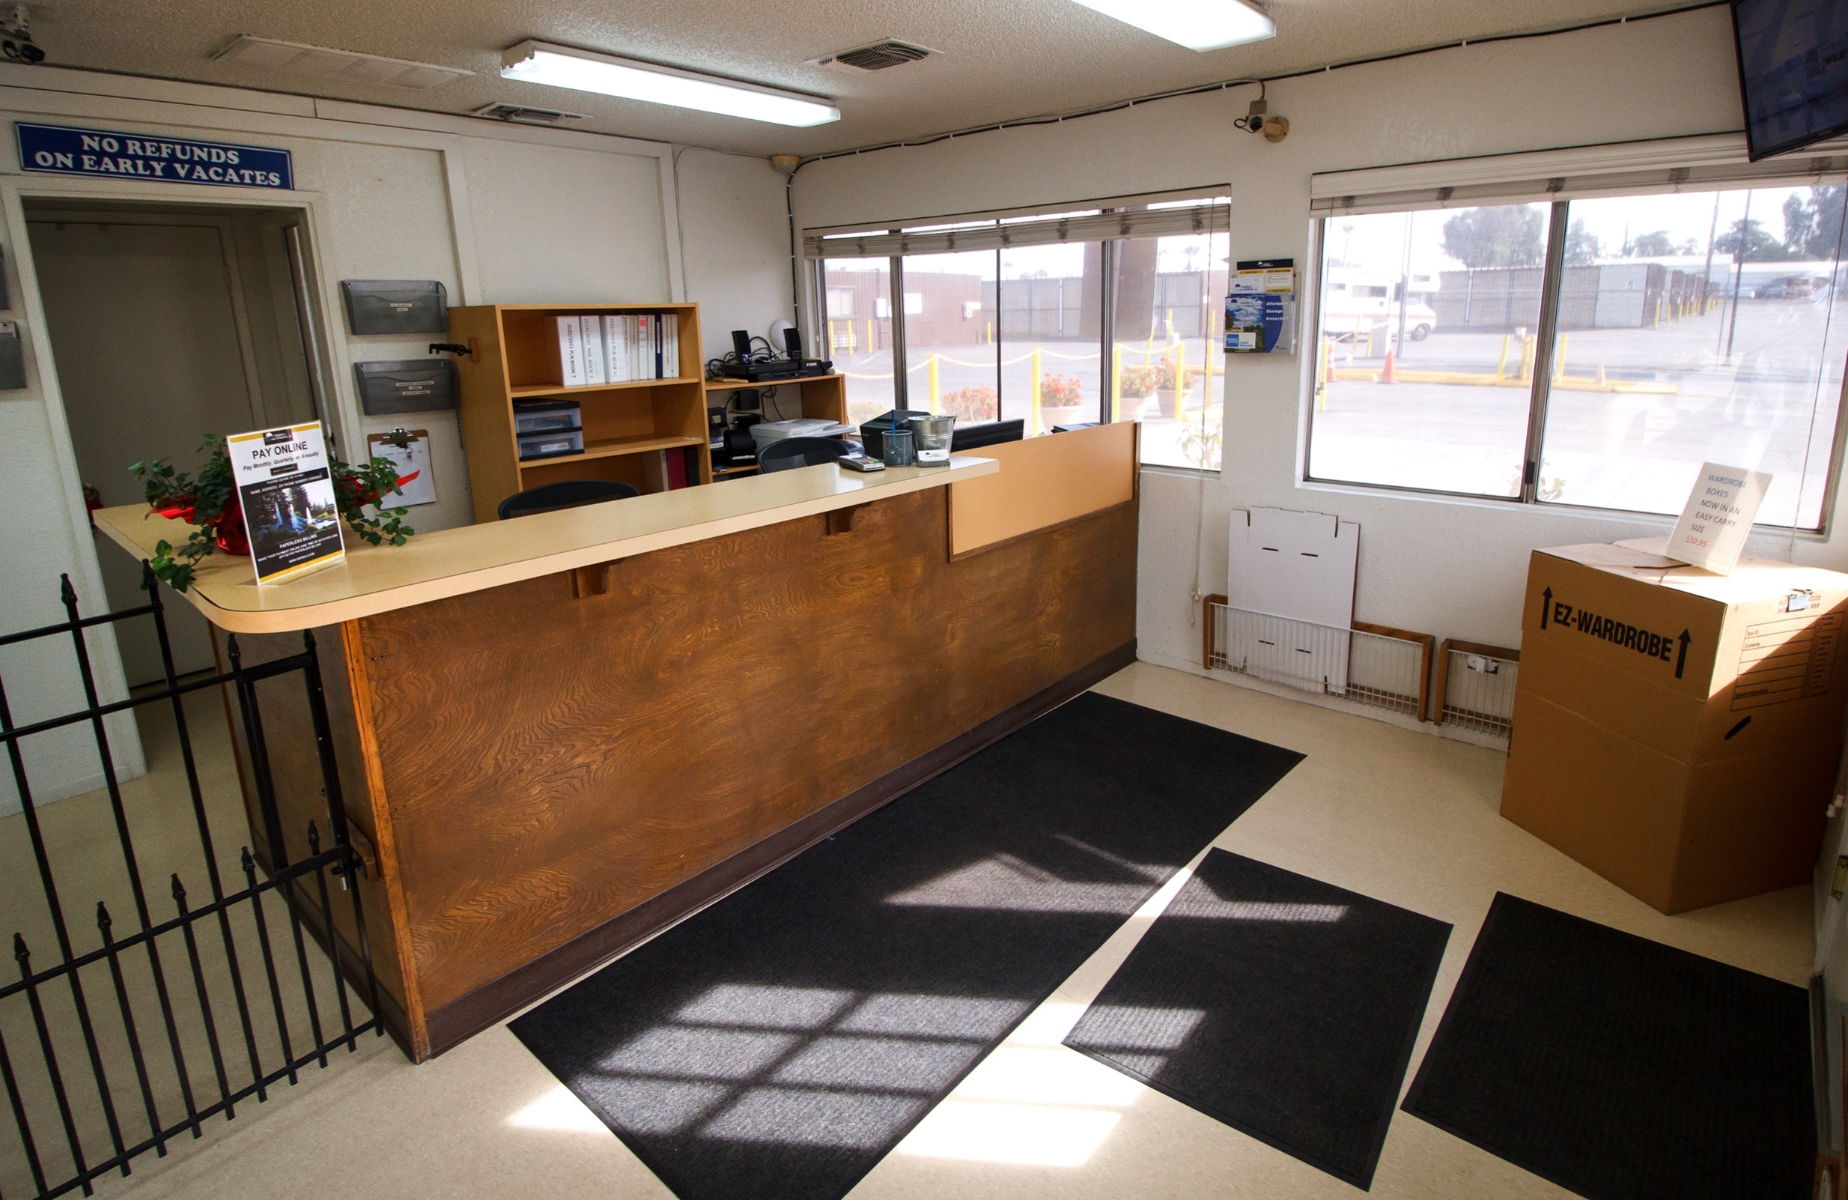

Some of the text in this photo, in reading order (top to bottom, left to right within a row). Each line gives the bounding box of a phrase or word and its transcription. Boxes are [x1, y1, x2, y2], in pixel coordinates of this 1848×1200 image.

[80, 135, 240, 164] NO REFUNDS
[35, 150, 282, 186] ON EARLY VACATES
[252, 441, 308, 460] PAY ONLINE
[1708, 474, 1748, 488] WARDROBE
[1706, 487, 1728, 498] BOXES
[1700, 499, 1741, 515] NOW IN AN
[1695, 512, 1736, 527] EASY CARRY
[1690, 524, 1705, 533] SIZE
[1685, 535, 1707, 548] $10.95
[1553, 602, 1674, 662] EZ-WARDROBE
